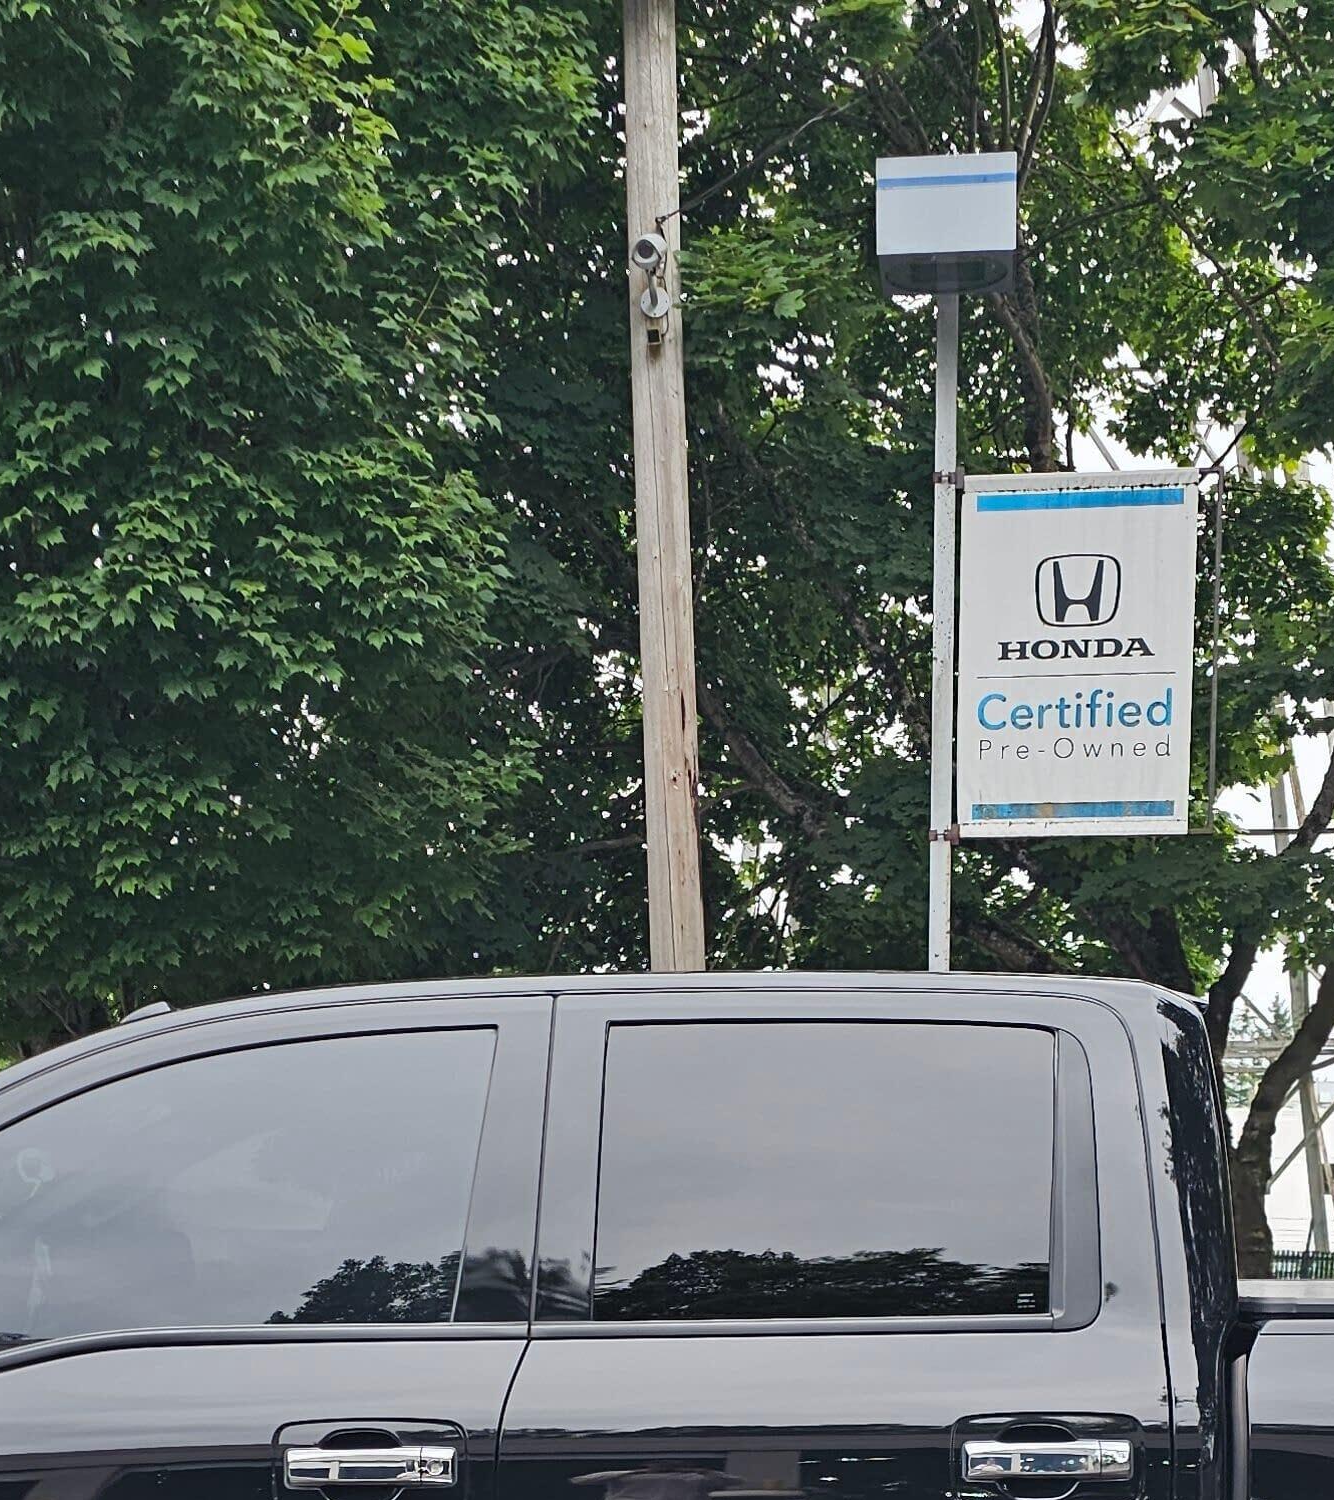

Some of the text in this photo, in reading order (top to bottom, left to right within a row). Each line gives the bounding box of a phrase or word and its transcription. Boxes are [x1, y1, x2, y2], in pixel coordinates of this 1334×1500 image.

[997, 637, 1155, 661] HONDA
[977, 688, 1173, 731] Certified
[978, 734, 1171, 760] Pre-Owned
